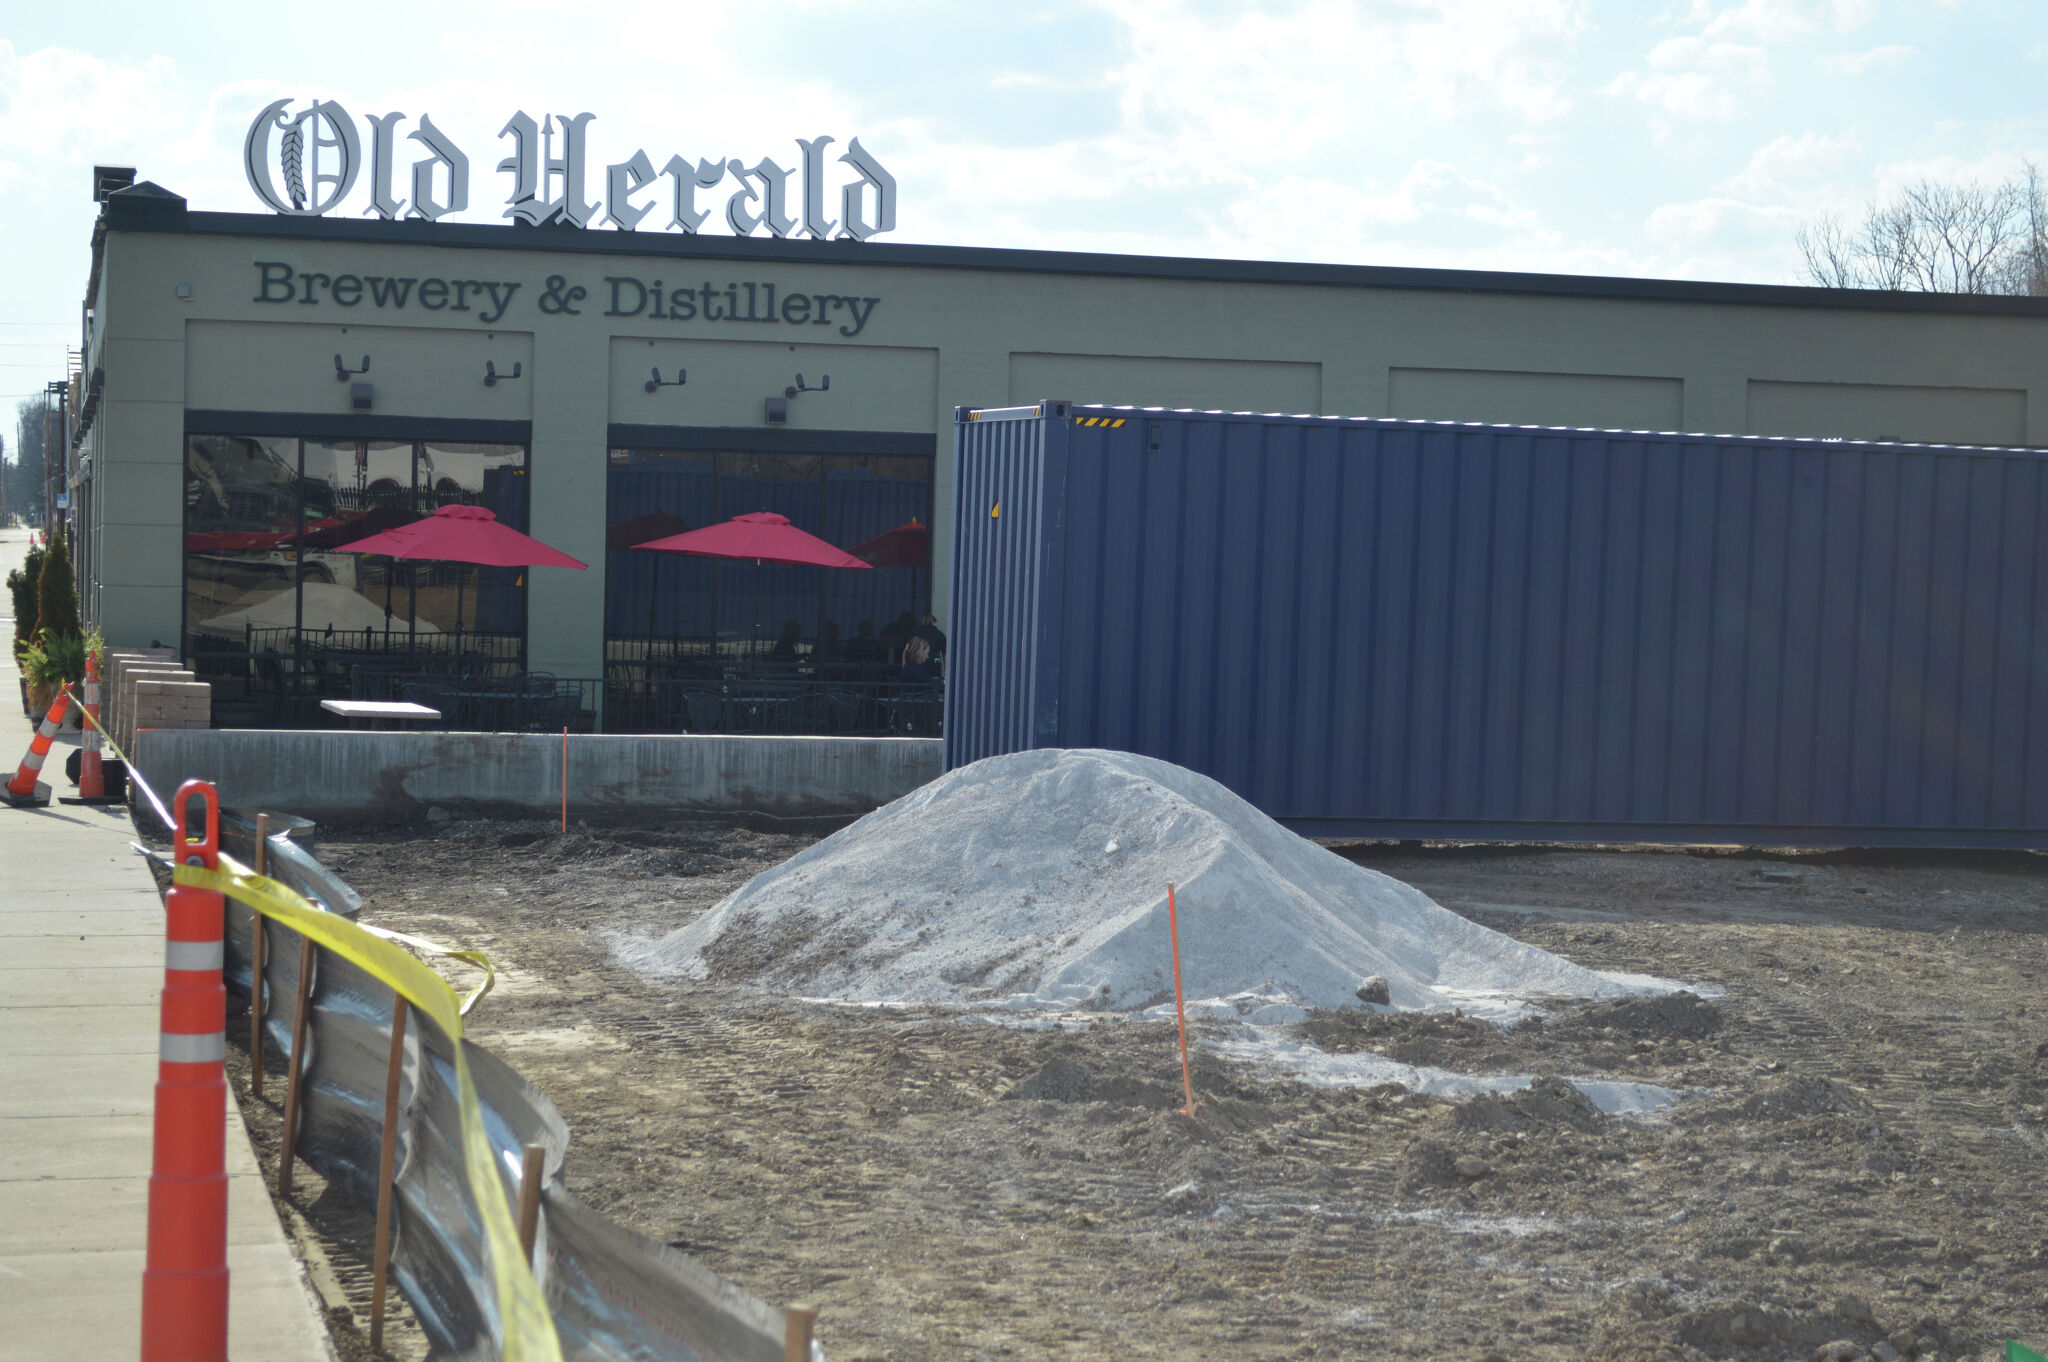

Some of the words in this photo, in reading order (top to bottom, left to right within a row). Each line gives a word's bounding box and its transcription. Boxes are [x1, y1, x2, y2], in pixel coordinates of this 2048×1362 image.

[243, 97, 469, 223] Old
[496, 109, 897, 242] Herald
[253, 261, 522, 324] Brewery
[538, 274, 588, 315] &
[603, 276, 881, 336] Distillery
